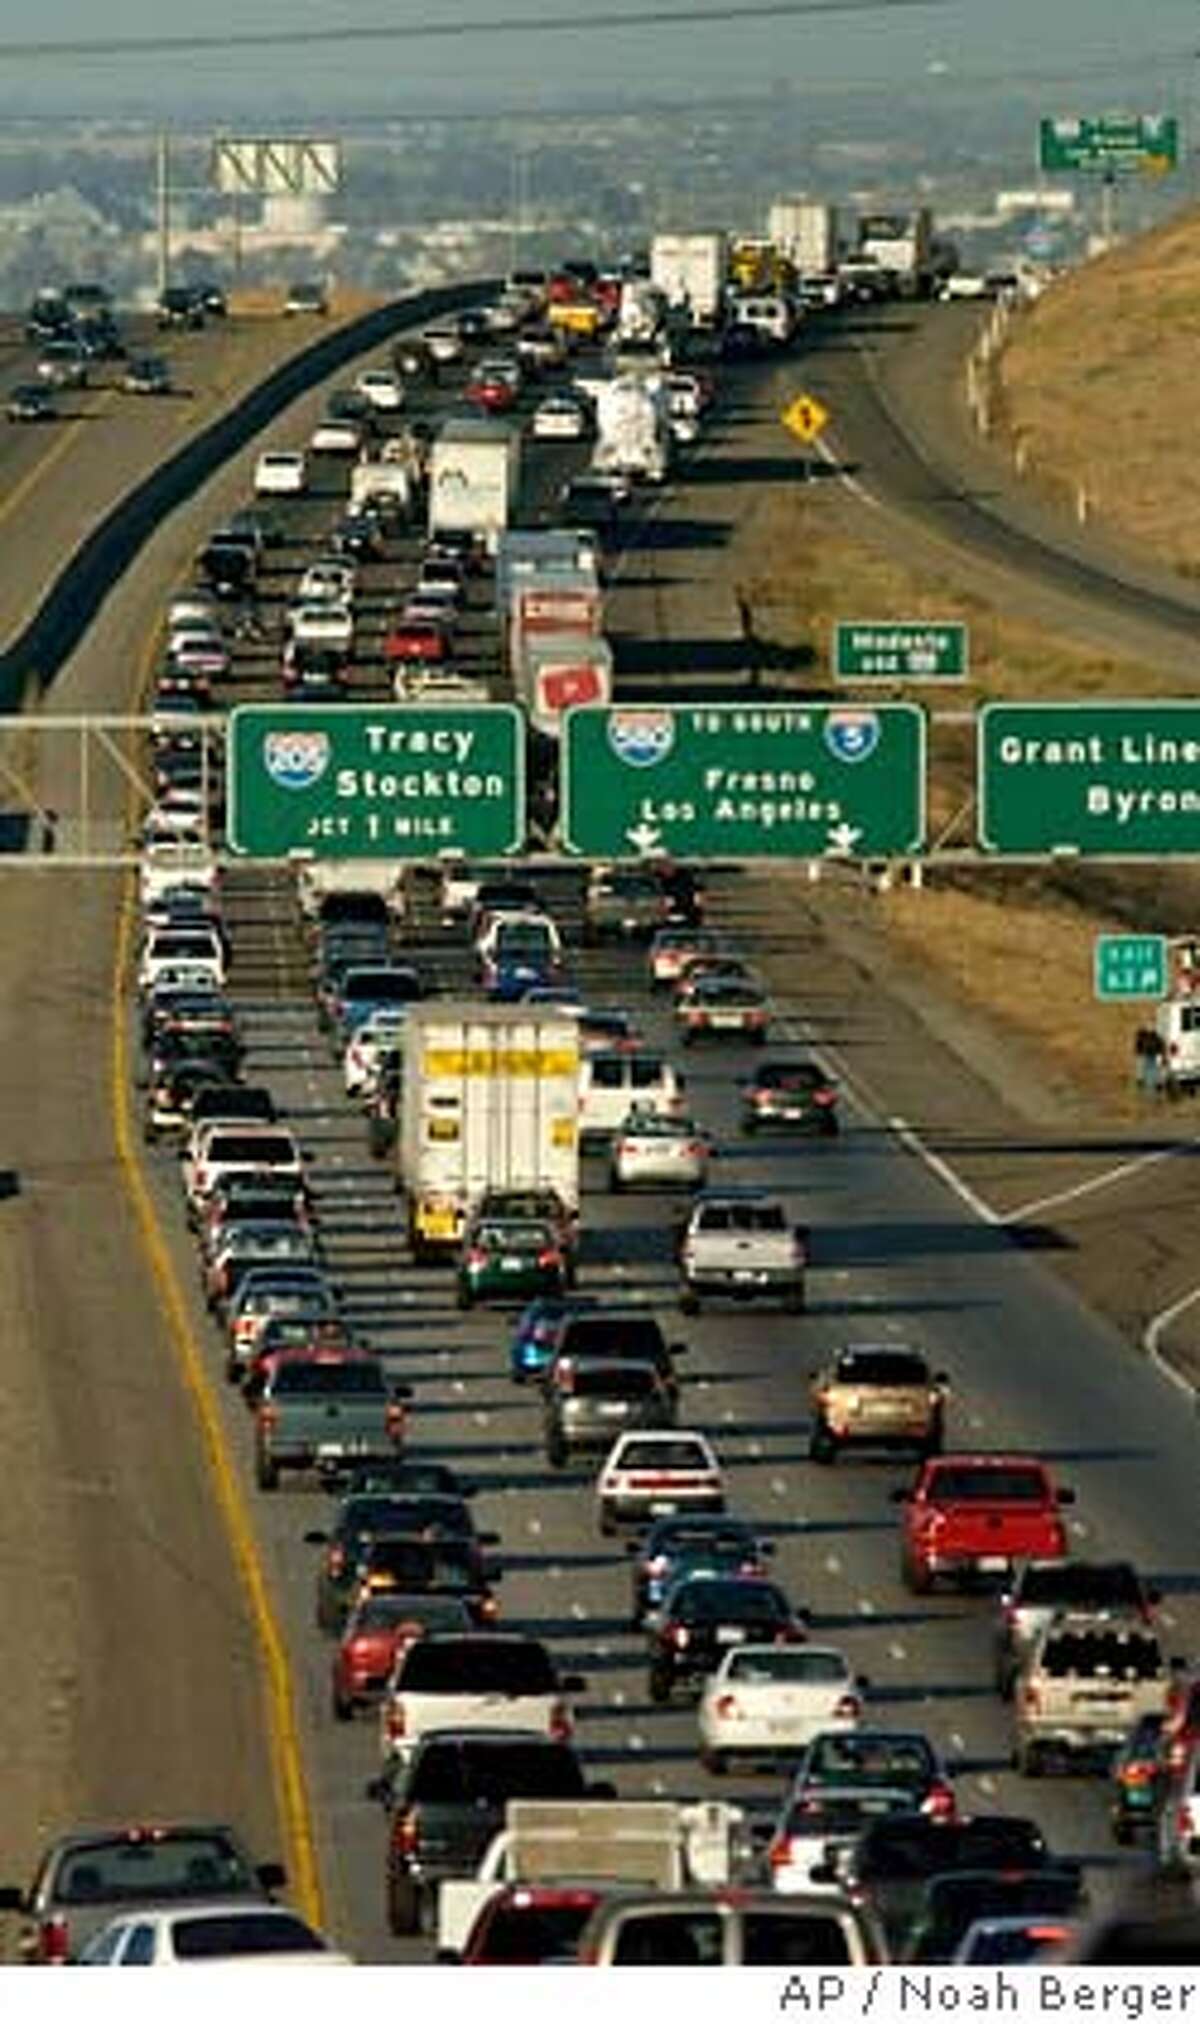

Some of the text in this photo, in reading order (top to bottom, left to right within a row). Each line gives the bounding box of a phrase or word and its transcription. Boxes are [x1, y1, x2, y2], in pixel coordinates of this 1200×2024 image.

[365, 726, 475, 763] Tracy
[1000, 732, 1200, 764] Grant Line
[335, 769, 503, 798] Stockton
[704, 768, 816, 792] Fresno
[641, 798, 842, 829] Los Angeles
[1087, 785, 1200, 824] Byron
[368, 814, 379, 839] 1
[394, 816, 455, 836] MILE
